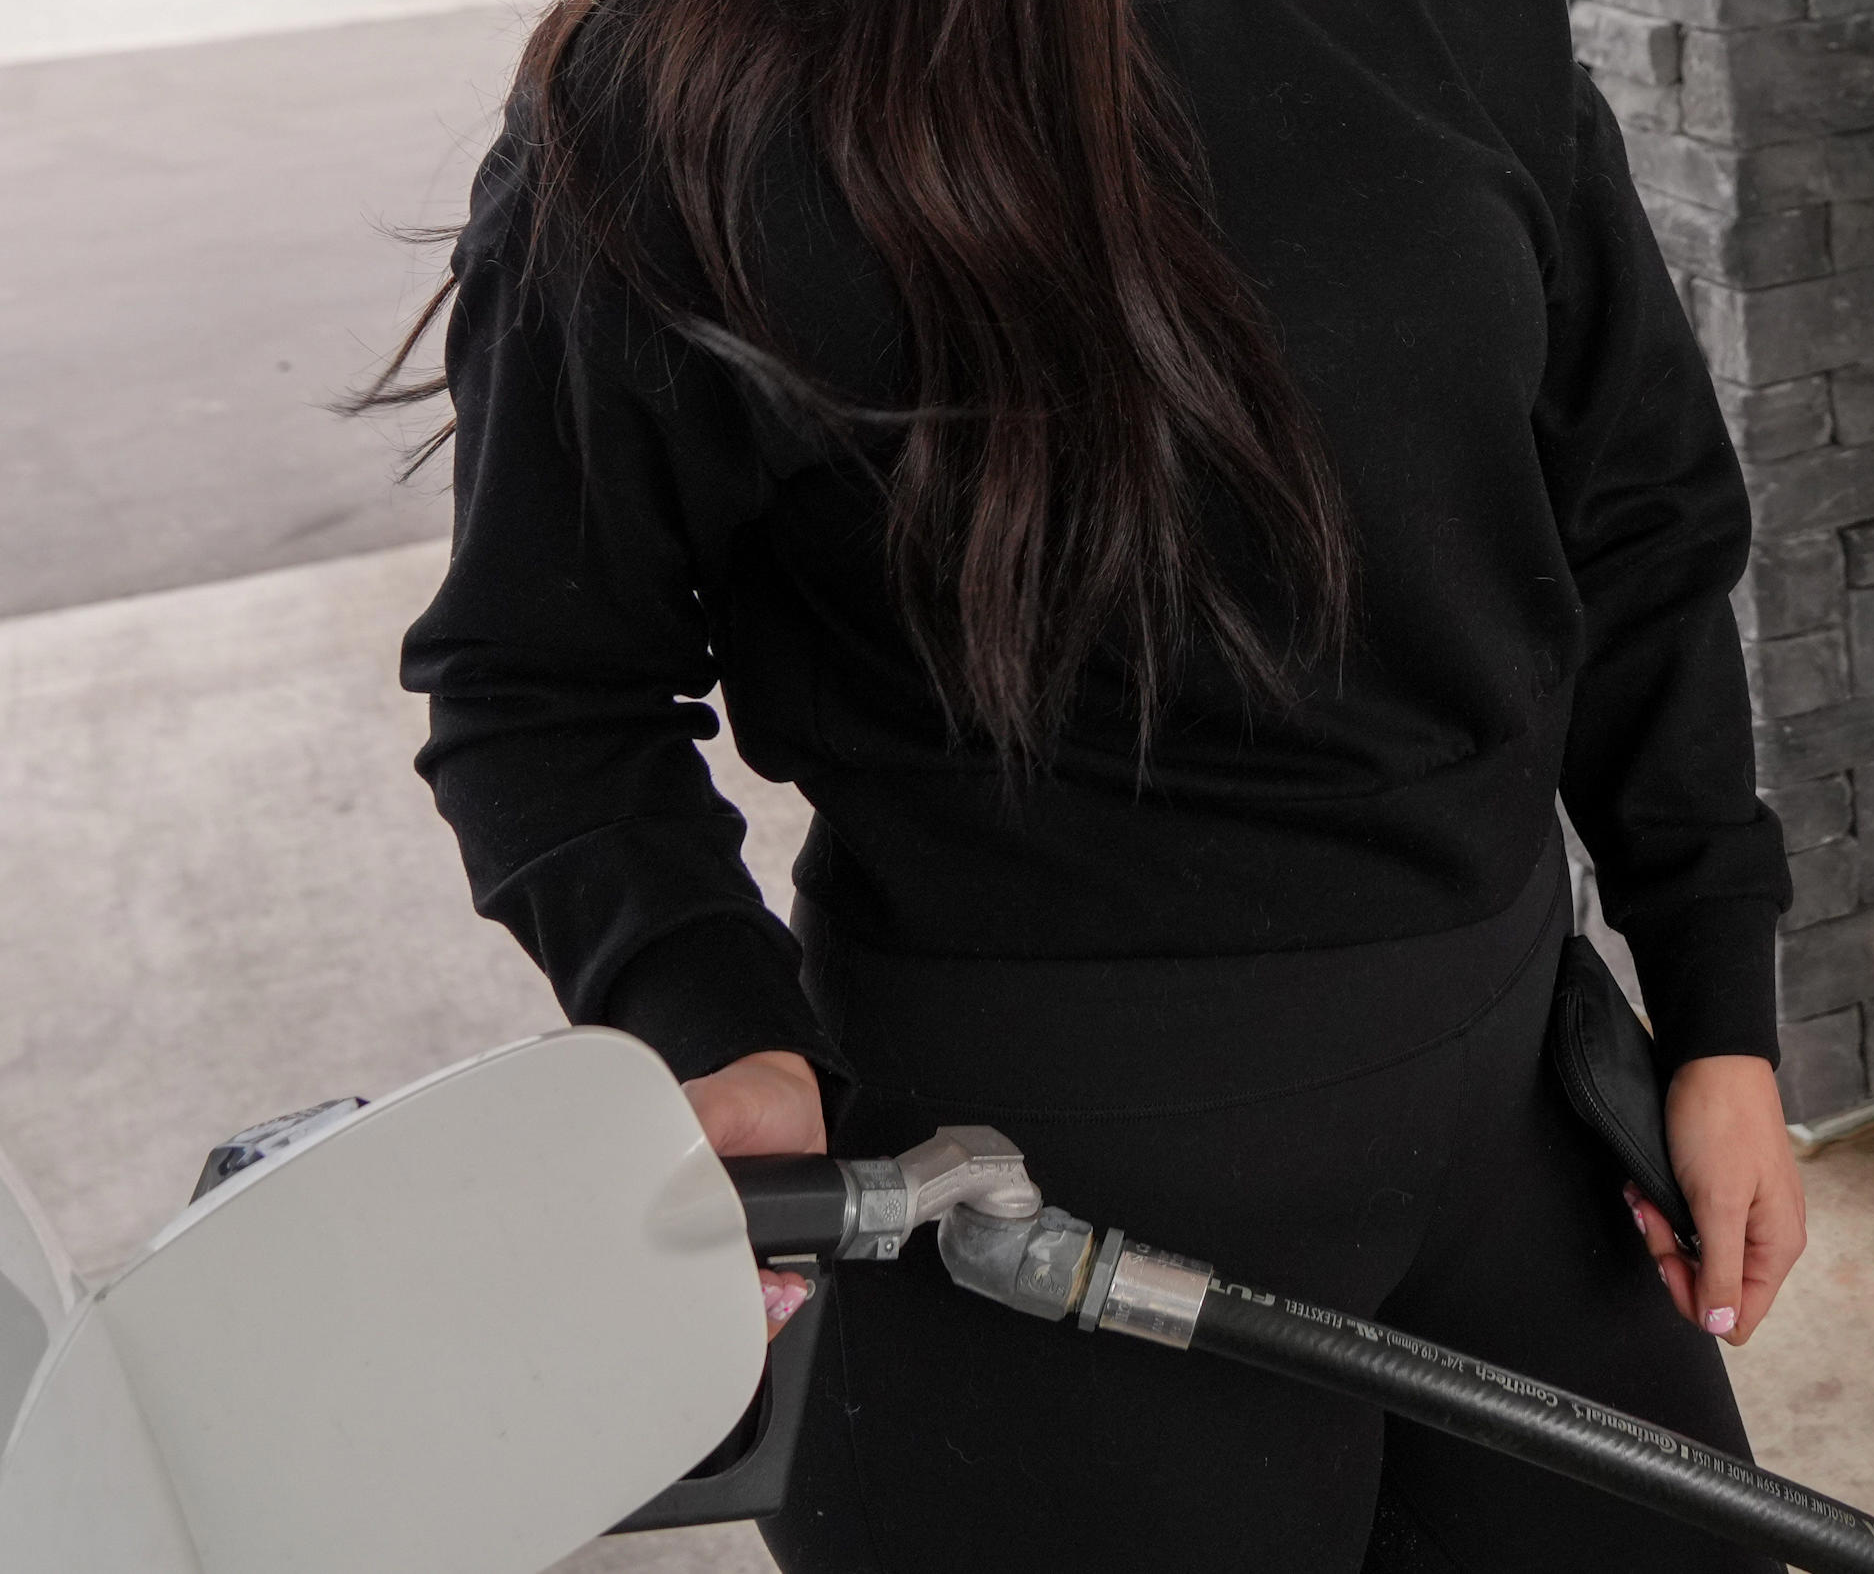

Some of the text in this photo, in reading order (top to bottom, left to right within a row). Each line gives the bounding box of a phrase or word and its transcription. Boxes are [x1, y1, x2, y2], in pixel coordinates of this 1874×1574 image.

[1284, 1297, 1343, 1329] FLEXSTEEL
[1475, 1365, 1559, 1407] ContiTech
[1691, 1448, 1712, 1464] USA
[1713, 1456, 1725, 1469] IN
[1728, 1460, 1754, 1483] MADE
[1784, 1484, 1809, 1506] HOSE
[1811, 1494, 1857, 1527] GASOLINE
